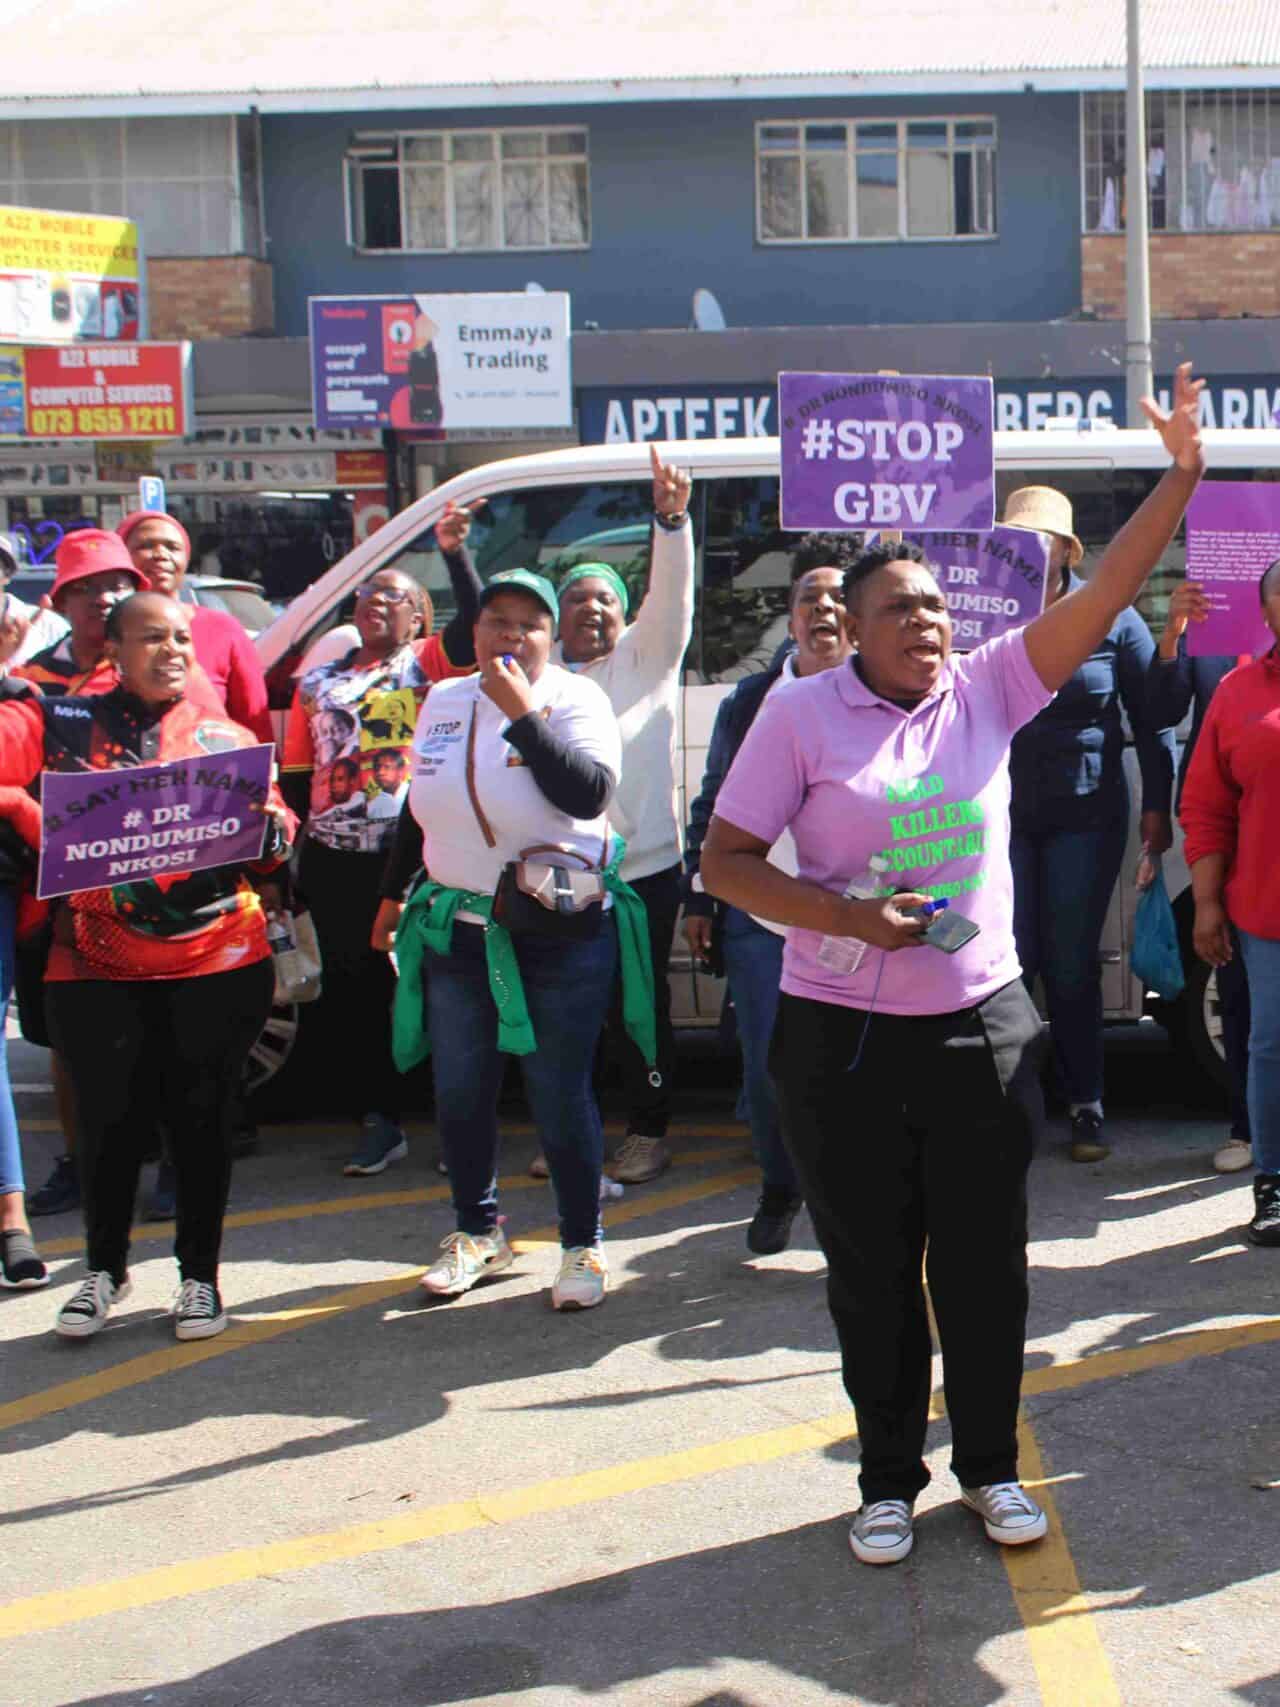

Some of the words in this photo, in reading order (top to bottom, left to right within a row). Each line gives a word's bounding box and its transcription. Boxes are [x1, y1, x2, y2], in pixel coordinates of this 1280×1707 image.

[458, 325, 553, 346] Emmaya
[464, 350, 550, 373] Trading
[30, 386, 105, 406] COMPUTER
[107, 384, 174, 405] SERVICES
[32, 408, 74, 434] 073
[78, 407, 123, 433] 855
[127, 405, 176, 432] 1211
[604, 396, 771, 445] APTEEK
[801, 417, 965, 462] #STOP
[146, 481, 158, 505] P
[833, 480, 938, 524] GBV
[946, 565, 979, 585] DR
[983, 538, 1043, 590] NAME
[945, 591, 1020, 617] UMISO
[950, 618, 984, 638] OSI
[65, 785, 121, 819] SAY
[128, 768, 187, 795] HER
[122, 809, 144, 830] #
[151, 803, 192, 826] DR
[65, 816, 241, 862] NONDUMISO
[107, 848, 197, 877] NKOSI
